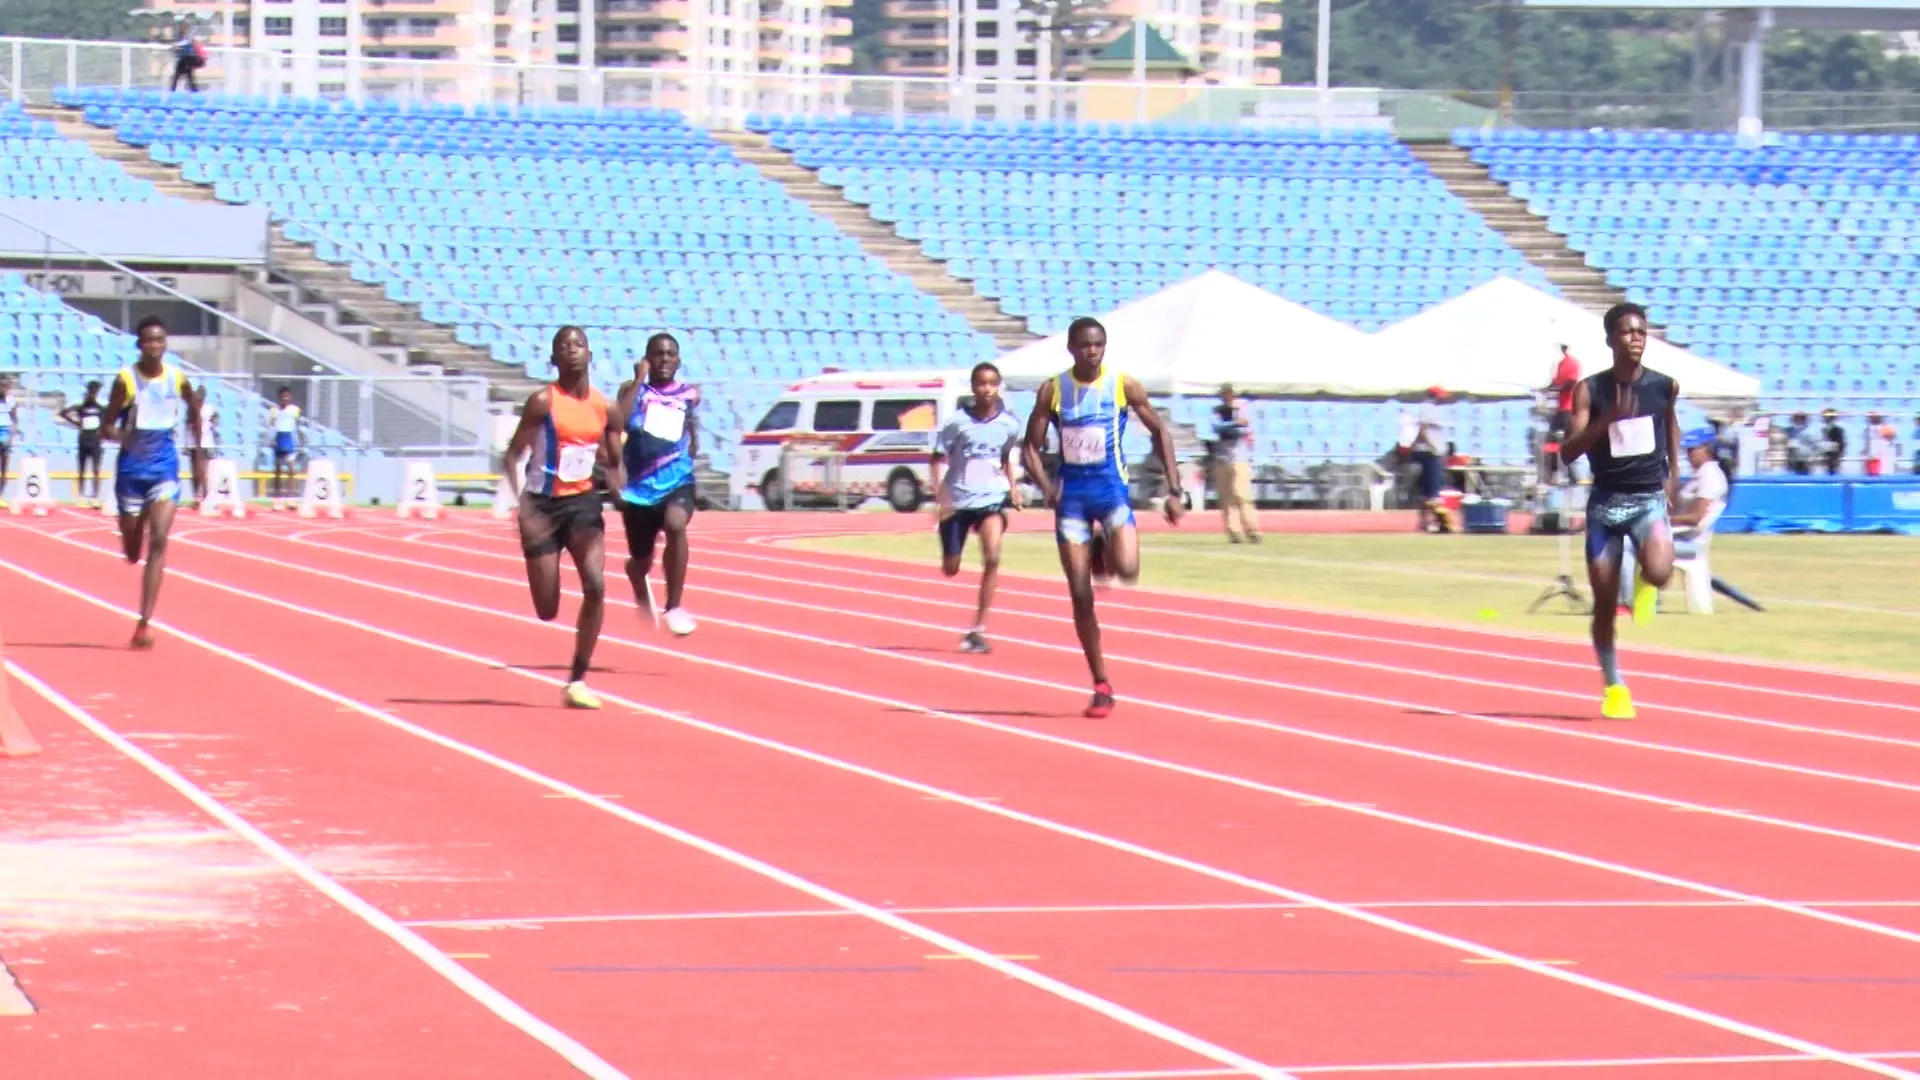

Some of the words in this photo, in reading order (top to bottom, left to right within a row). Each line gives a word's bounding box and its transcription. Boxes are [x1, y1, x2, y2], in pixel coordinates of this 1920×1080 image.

[26, 474, 40, 498] 6
[217, 476, 231, 498] 4
[316, 476, 329, 500] 3
[414, 478, 428, 500] 2
